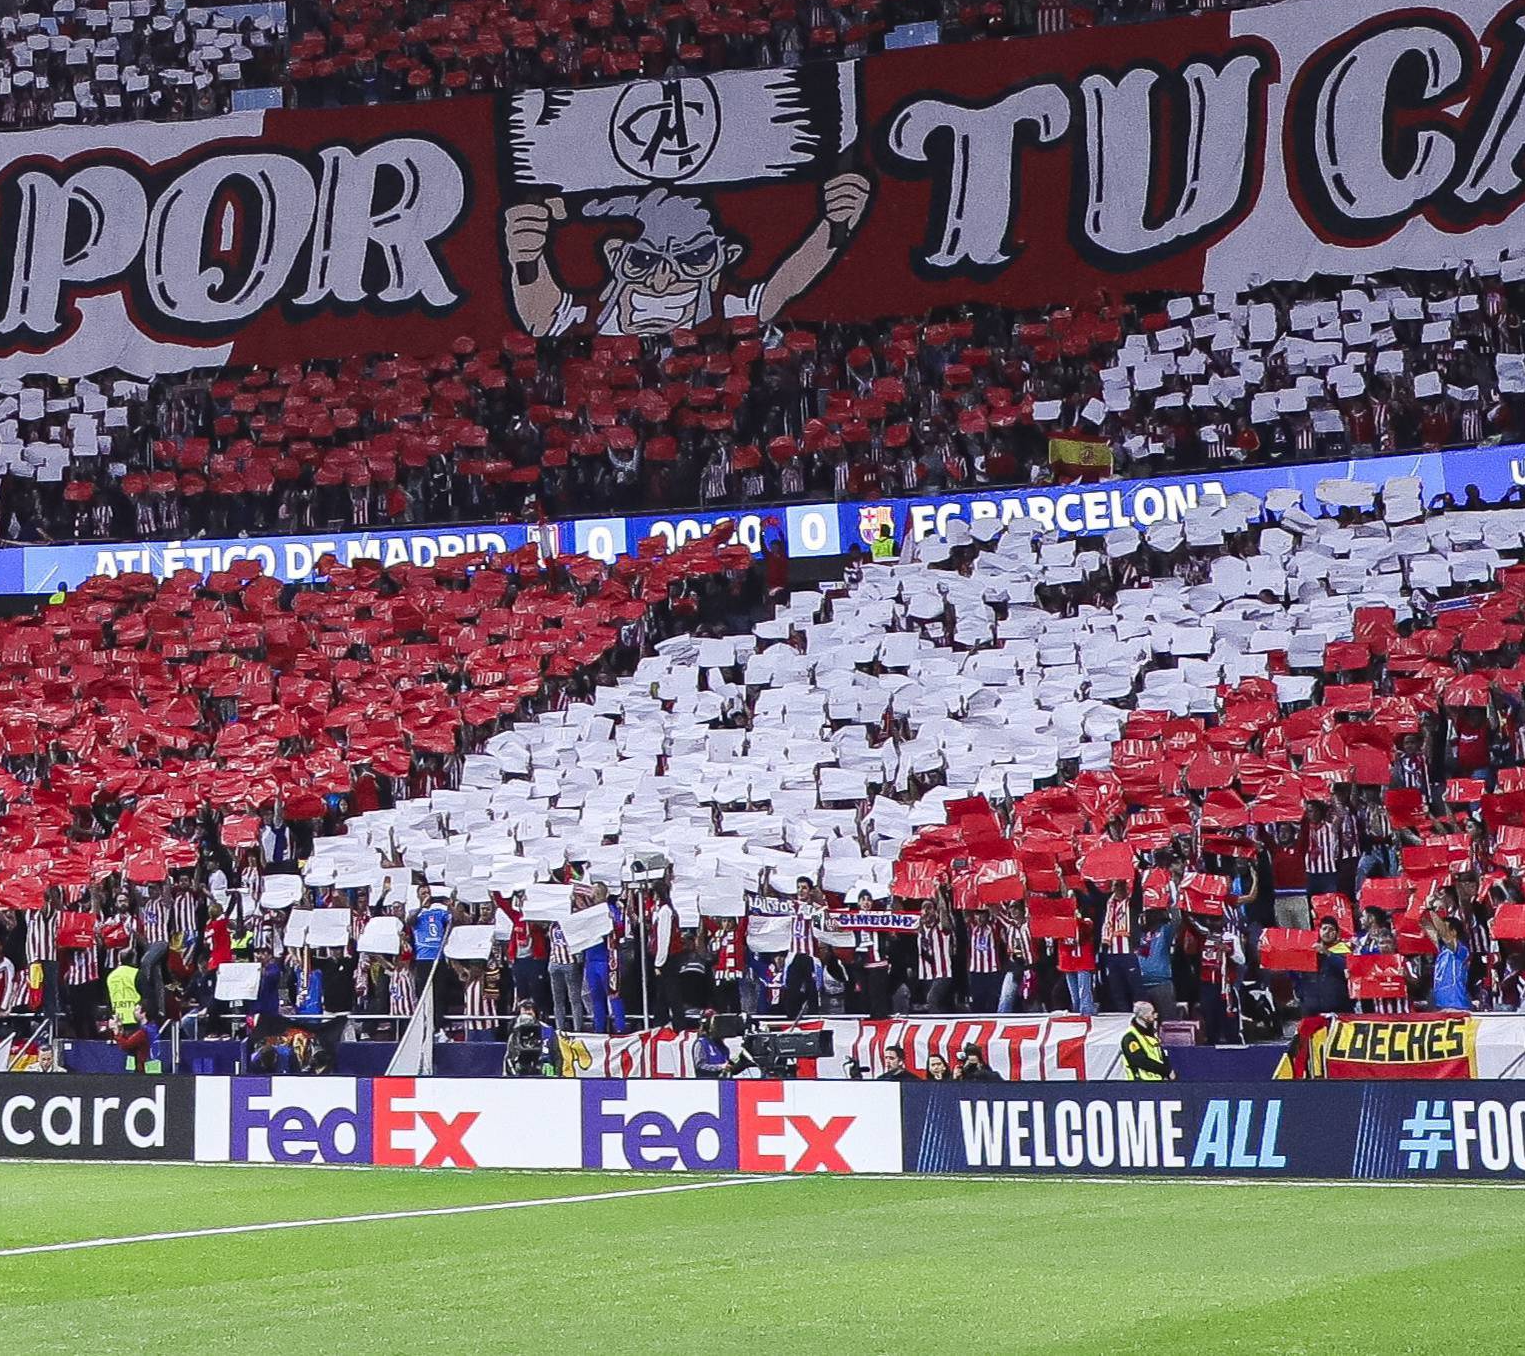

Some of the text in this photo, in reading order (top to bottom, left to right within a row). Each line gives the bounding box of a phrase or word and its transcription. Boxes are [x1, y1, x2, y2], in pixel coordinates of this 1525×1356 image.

[888, 54, 1262, 268] TU
[800, 512, 827, 551] 0
[1329, 1018, 1468, 1062] LOECHES
[230, 1075, 482, 1168] FedEx
[581, 1078, 857, 1173] FedEx
[959, 1097, 1287, 1169] WELCOME ALL
